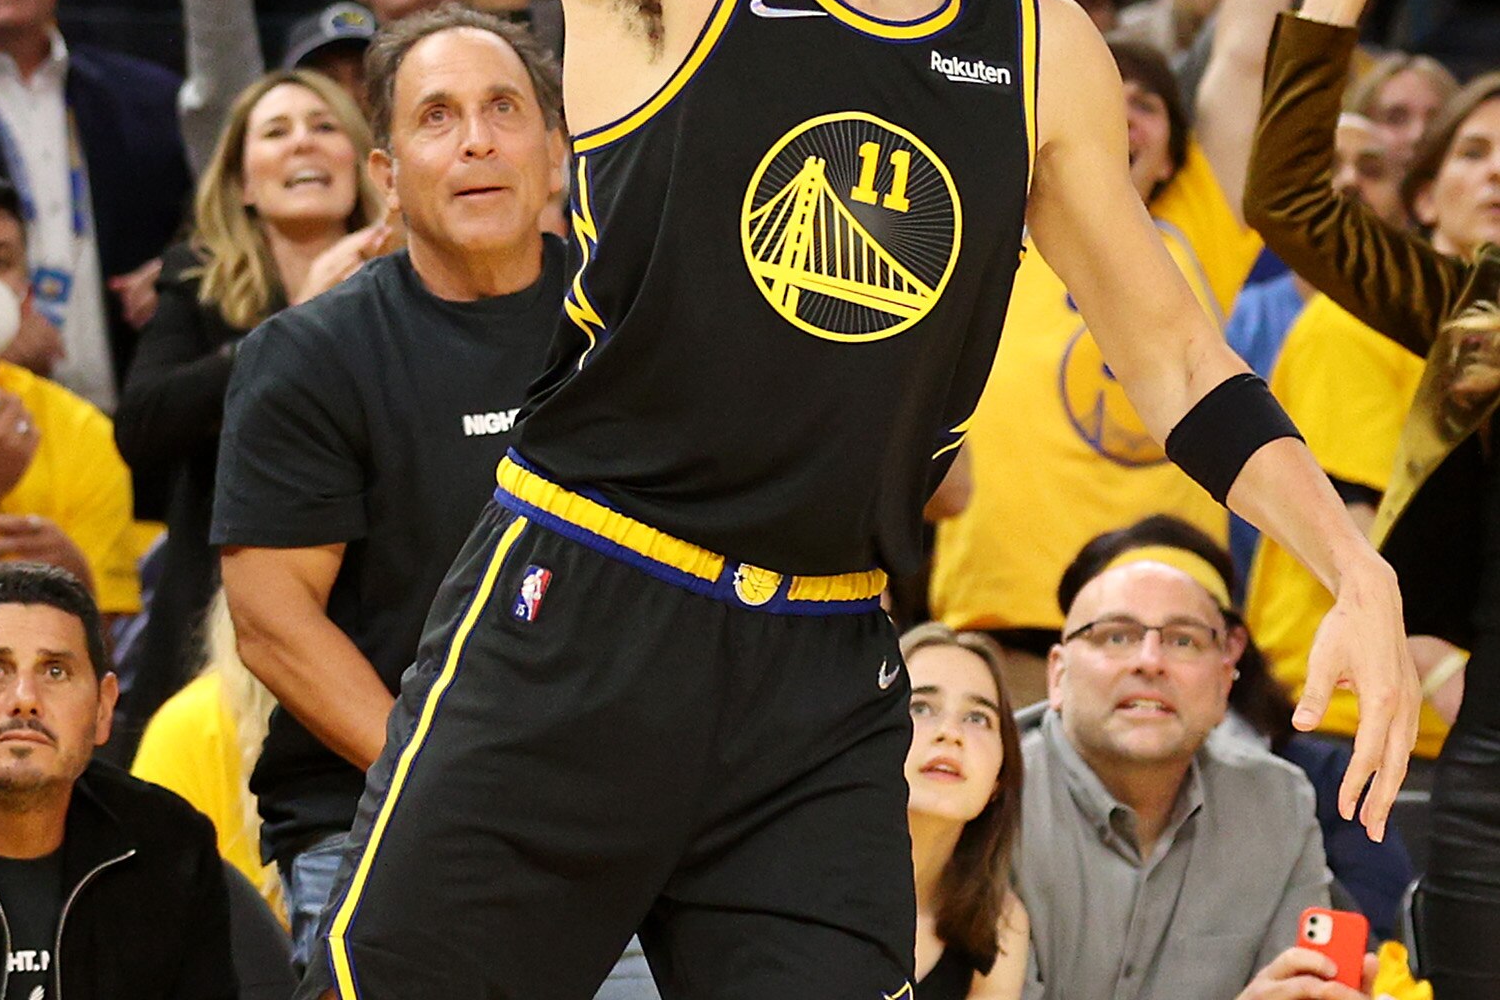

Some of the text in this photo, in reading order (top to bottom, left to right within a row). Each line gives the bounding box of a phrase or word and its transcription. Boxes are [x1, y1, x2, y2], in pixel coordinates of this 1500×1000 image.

[930, 50, 1011, 85] Rakuten
[850, 141, 911, 213] 11
[463, 407, 521, 436] NIGH
